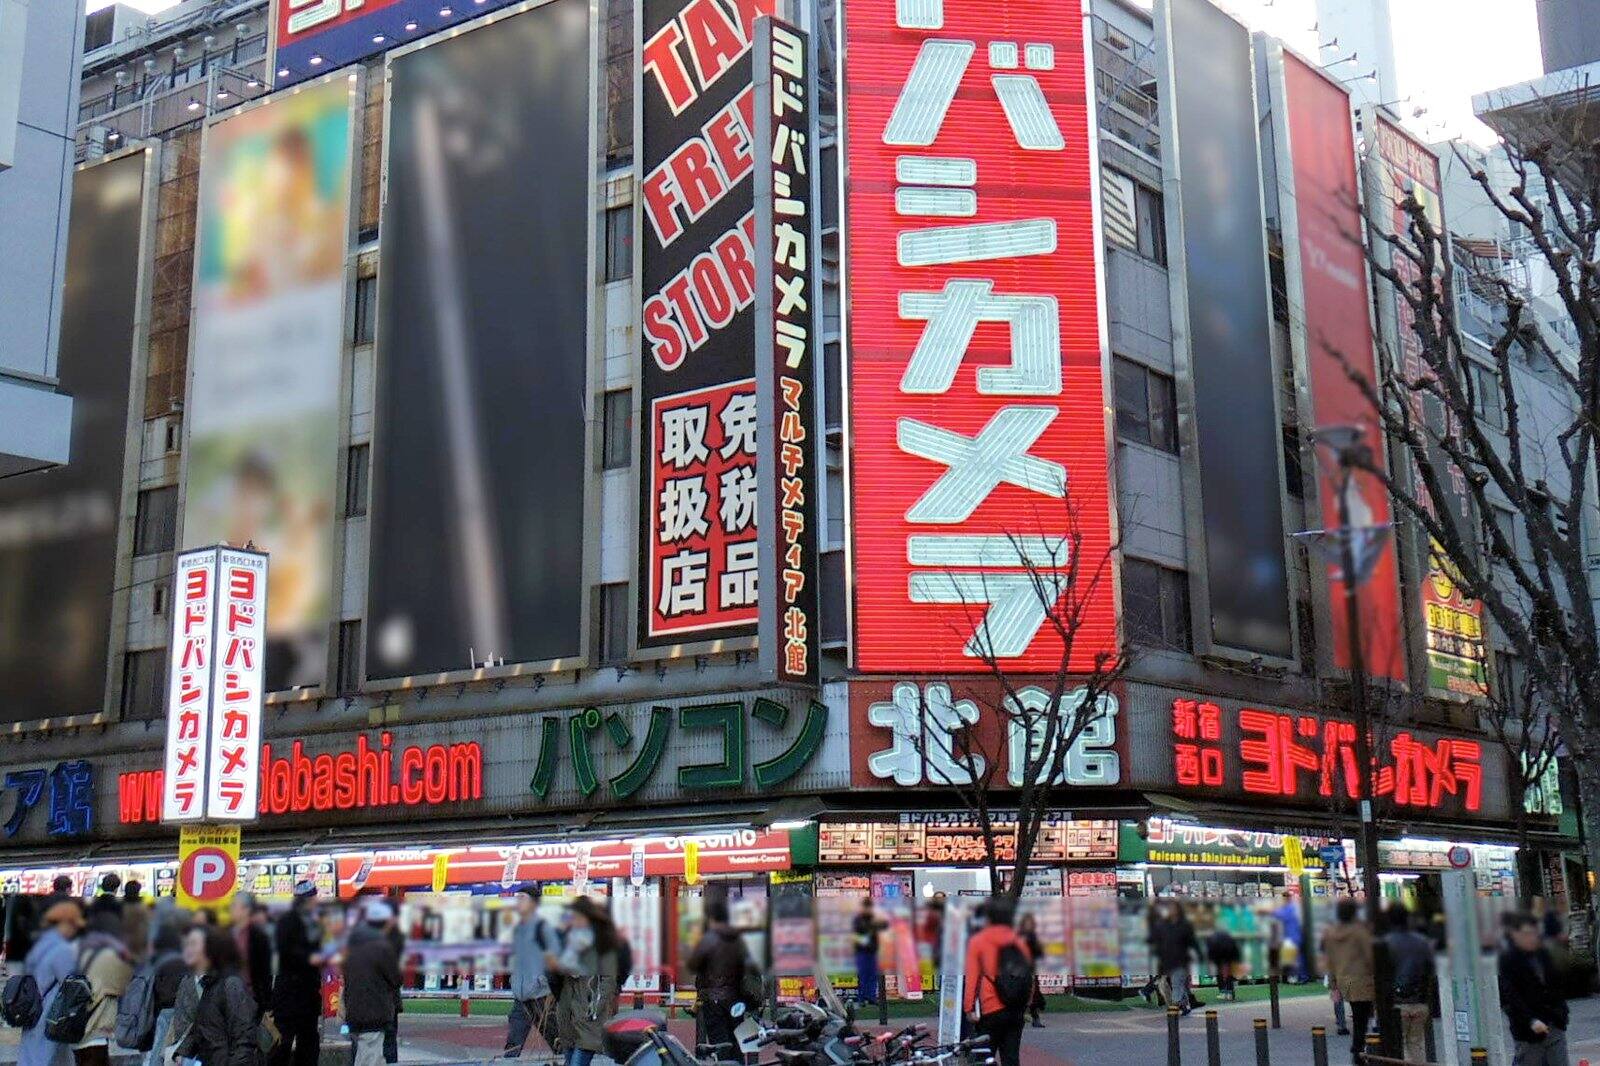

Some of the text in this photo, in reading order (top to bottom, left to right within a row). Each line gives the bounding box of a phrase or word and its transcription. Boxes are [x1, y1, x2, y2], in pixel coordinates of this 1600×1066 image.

[643, 80, 754, 249] FRE
[771, 25, 807, 369] ヨドバシカメラ
[643, 208, 755, 372] STOR
[882, 0, 1070, 658] バシカメラ
[175, 567, 208, 817] ヨドバシカメラ
[218, 567, 257, 815] ヨドバシカメラ
[531, 698, 829, 798] パソコン
[868, 681, 1120, 786] 北館
[192, 855, 225, 896] P
